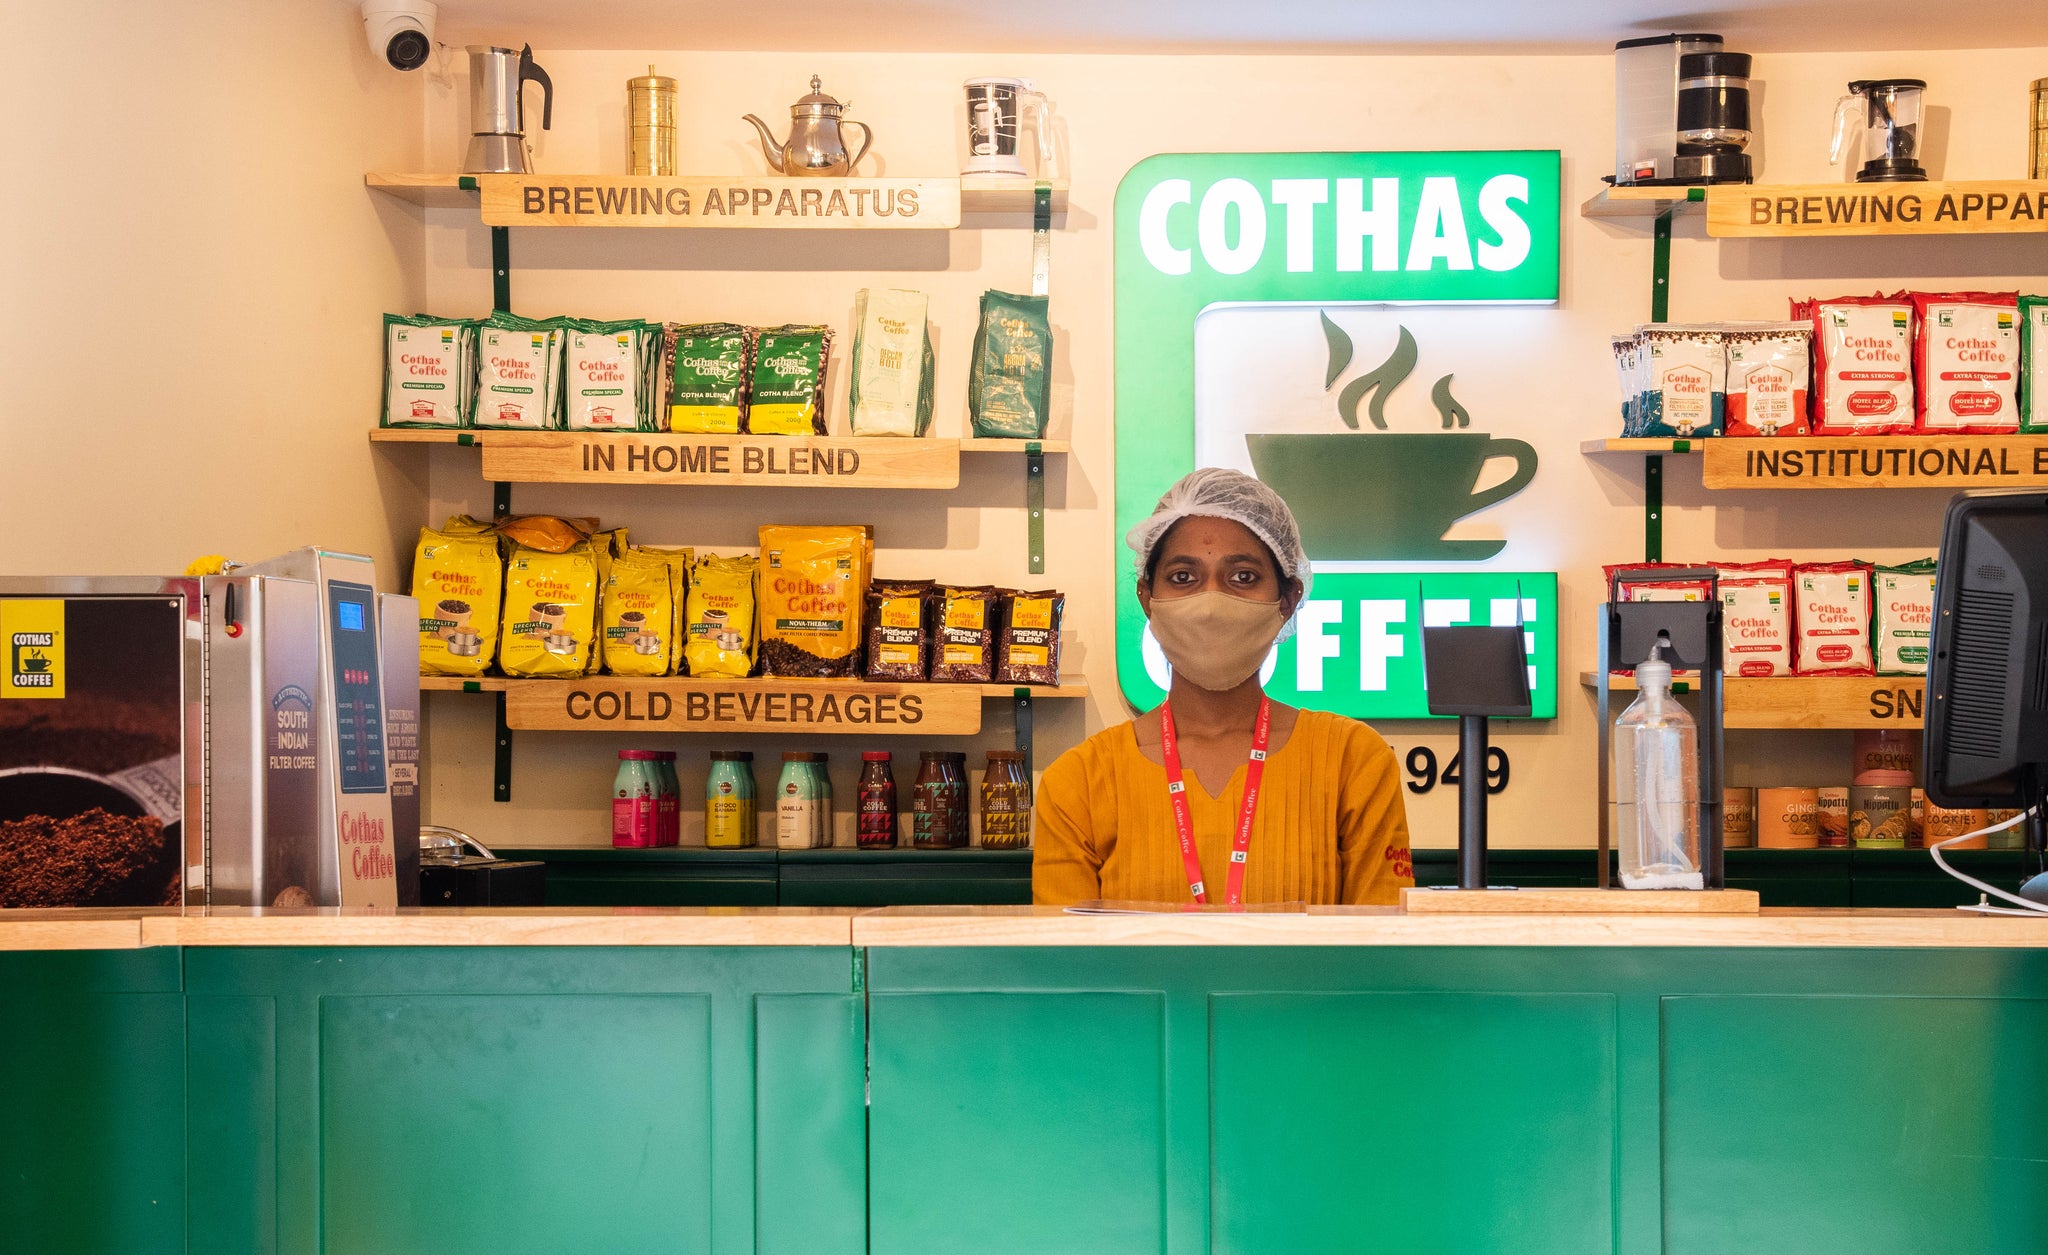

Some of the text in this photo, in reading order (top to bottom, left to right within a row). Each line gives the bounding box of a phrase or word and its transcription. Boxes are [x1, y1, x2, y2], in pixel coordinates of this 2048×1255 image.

[524, 186, 919, 217] BREWING APPARATUS
[1750, 195, 1921, 224] BREWING
[1139, 174, 1531, 275] COTHAS
[878, 317, 906, 327] Cothas
[883, 325, 909, 335] Coffee
[1844, 336, 1893, 348] Cothas
[1946, 337, 1997, 349] Cothas
[401, 354, 441, 365] Cothas
[1855, 349, 1901, 362] Coffee
[1957, 350, 2006, 363] Coffee
[491, 357, 530, 369] Cothas
[579, 360, 618, 371] Cothas
[683, 357, 719, 367] Cothas
[764, 356, 799, 367] Cothas
[409, 365, 447, 376] Coffee
[499, 368, 536, 380] Coffee
[696, 366, 729, 376] Coffee
[588, 371, 625, 382] Coffee
[1667, 373, 1701, 384] Cothas
[1750, 374, 1783, 384] Cothas
[1674, 383, 1706, 394] Coffee
[582, 444, 860, 476] IN HOME BLEND
[1746, 448, 2019, 477] INSTITUTIONAL
[432, 570, 476, 585] Cothas
[441, 583, 483, 596] Coffee
[526, 578, 570, 591] Cothas
[774, 578, 836, 596] Cothas
[535, 589, 577, 601] Coffee
[617, 592, 651, 600] Cothas
[702, 592, 734, 601] Cothas
[625, 601, 656, 609] Coffee
[708, 600, 739, 609] Coffee
[787, 596, 847, 614] Coffee
[1809, 602, 1848, 614] Cothas
[1891, 602, 1931, 613] Cothas
[885, 610, 910, 619] Cothas
[949, 611, 974, 620] Cothas
[1016, 611, 1042, 620] Cothas
[1818, 613, 1856, 624] Coffee
[1900, 612, 1931, 624] Coffe
[890, 618, 915, 627] Coffee
[954, 619, 979, 627] Coffee
[1021, 619, 1045, 627] Coffee
[1731, 618, 1771, 628] Cothas
[882, 629, 918, 637] PREMIUM
[946, 629, 981, 638] PREMIUM
[1013, 629, 1048, 638] PREMIUM
[1741, 628, 1779, 638] Coffee
[13, 634, 51, 646] COTHAS
[950, 636, 976, 644] BLEND
[1017, 636, 1043, 644] BLEND
[13, 674, 51, 686] COFFEE
[566, 691, 923, 724] COLD BEVERAGES
[277, 710, 308, 729] SOUTH
[1162, 709, 1172, 756] Cothas Coffee
[1258, 719, 1268, 744] Cothas
[278, 731, 308, 749] INDIAN
[1880, 744, 1905, 753] SALT
[270, 755, 315, 769] FILTER COFFEE
[1866, 753, 1913, 763] COOKIES
[1391, 745, 1510, 795] 949
[1786, 804, 1818, 813] GINGE
[1863, 800, 1900, 811] Nippattu
[1240, 788, 1257, 844] Cothas Coffee
[1927, 815, 1977, 825] COOKIES
[340, 810, 385, 845] Cothas
[1174, 800, 1190, 854] Cothas Coffee
[352, 847, 394, 880] Coffee
